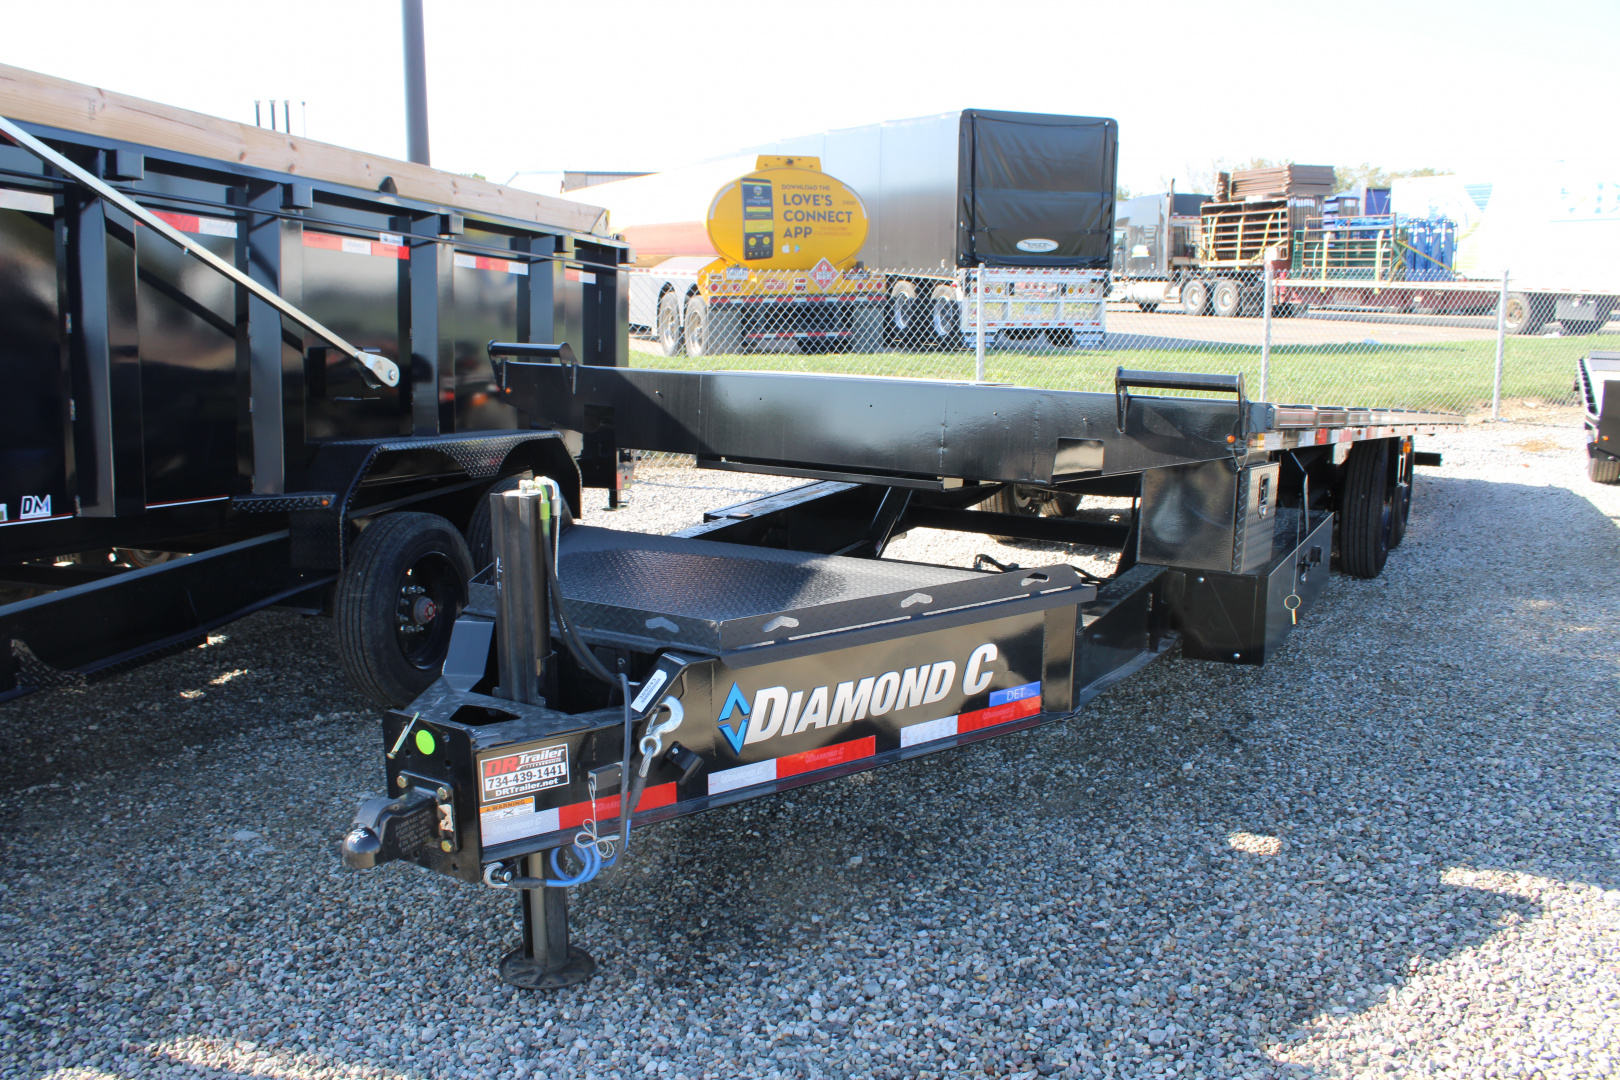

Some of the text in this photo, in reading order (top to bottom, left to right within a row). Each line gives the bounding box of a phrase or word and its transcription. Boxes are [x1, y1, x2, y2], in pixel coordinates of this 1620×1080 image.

[783, 193, 833, 206] LOVE'S
[783, 209, 853, 223] CONNECT
[783, 226, 813, 239] APP
[22, 495, 51, 513] DM
[743, 642, 998, 745] DIAMOND C
[1006, 687, 1026, 702] DET
[484, 756, 519, 778] DR
[518, 747, 566, 765] Trailer
[487, 765, 564, 789] 734-439-1441
[495, 777, 559, 797] DRTrailer.net
[492, 799, 525, 811] WARNING
